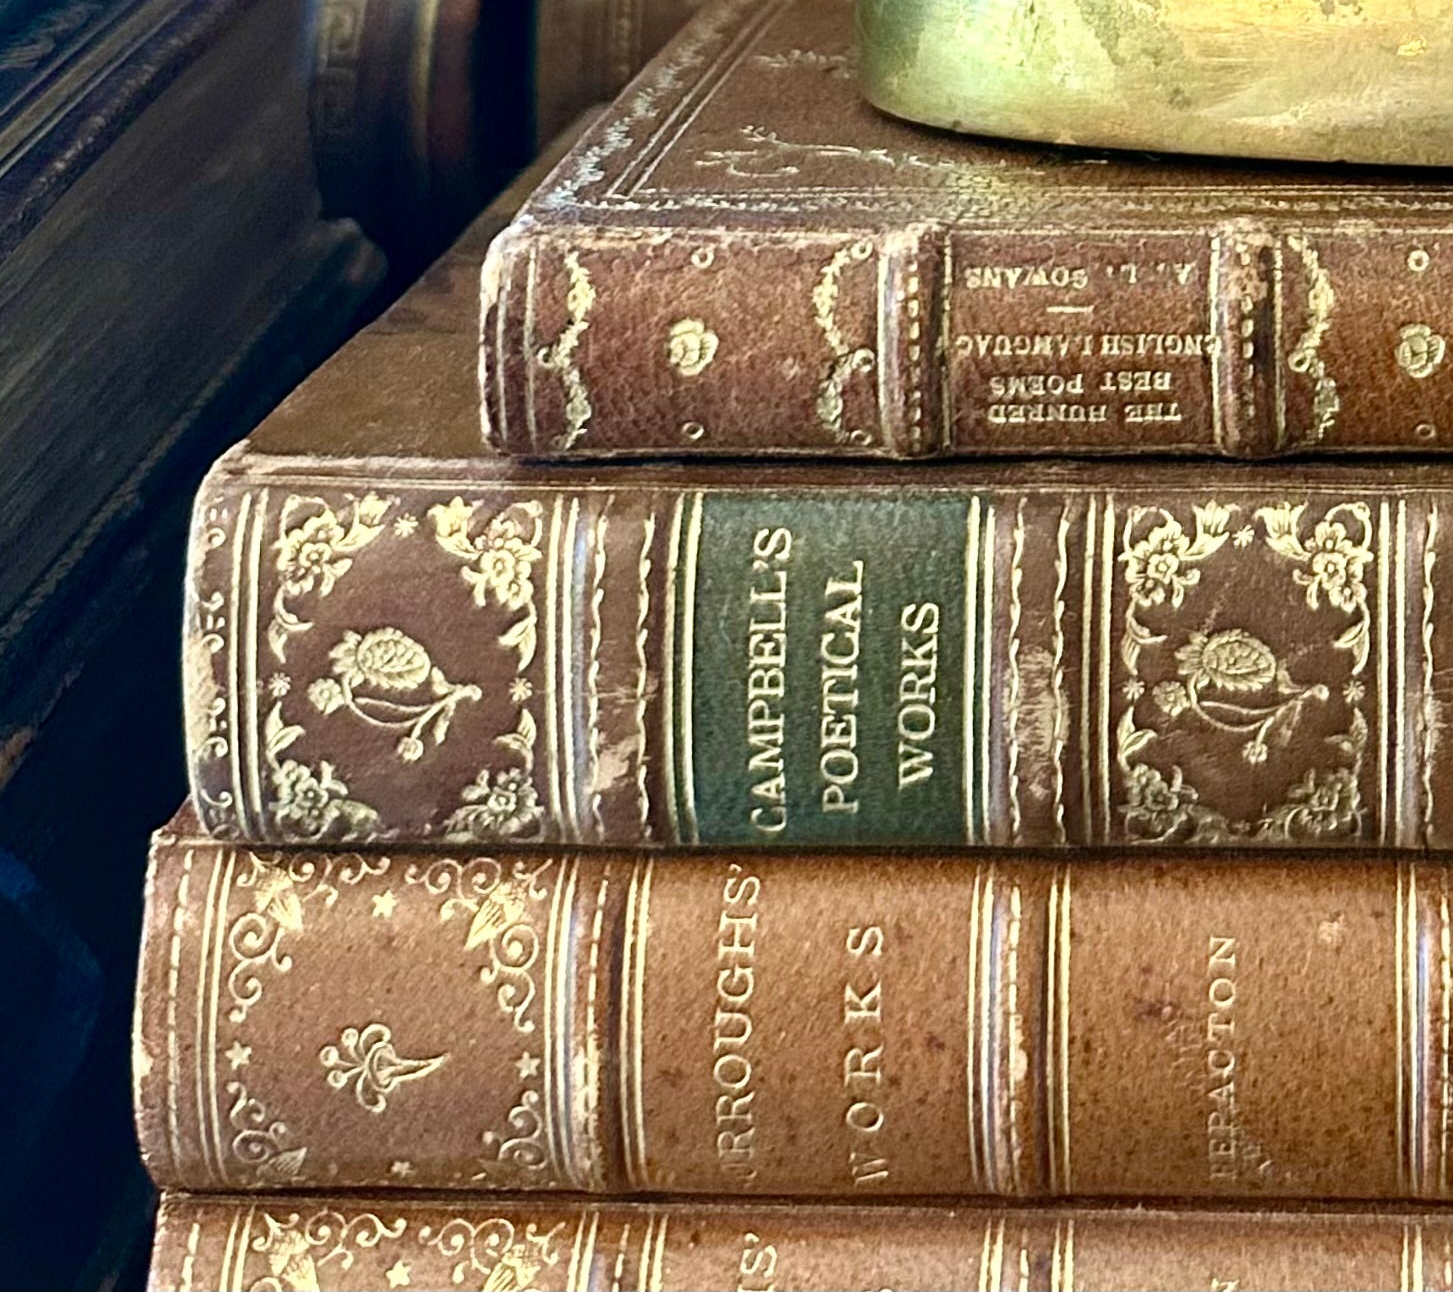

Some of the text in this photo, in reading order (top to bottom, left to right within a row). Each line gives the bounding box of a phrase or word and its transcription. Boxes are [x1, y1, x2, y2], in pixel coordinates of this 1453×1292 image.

[964, 265, 1089, 289] GOWANS
[989, 371, 1172, 396] BEST POEMS
[987, 401, 1182, 424] THE HUNRED
[748, 527, 793, 836] CAMPBELL'S
[819, 560, 864, 815] POETICAL
[898, 601, 941, 793] WORKS
[711, 863, 762, 1185] URROUGHS'
[843, 925, 889, 1187] WORKS
